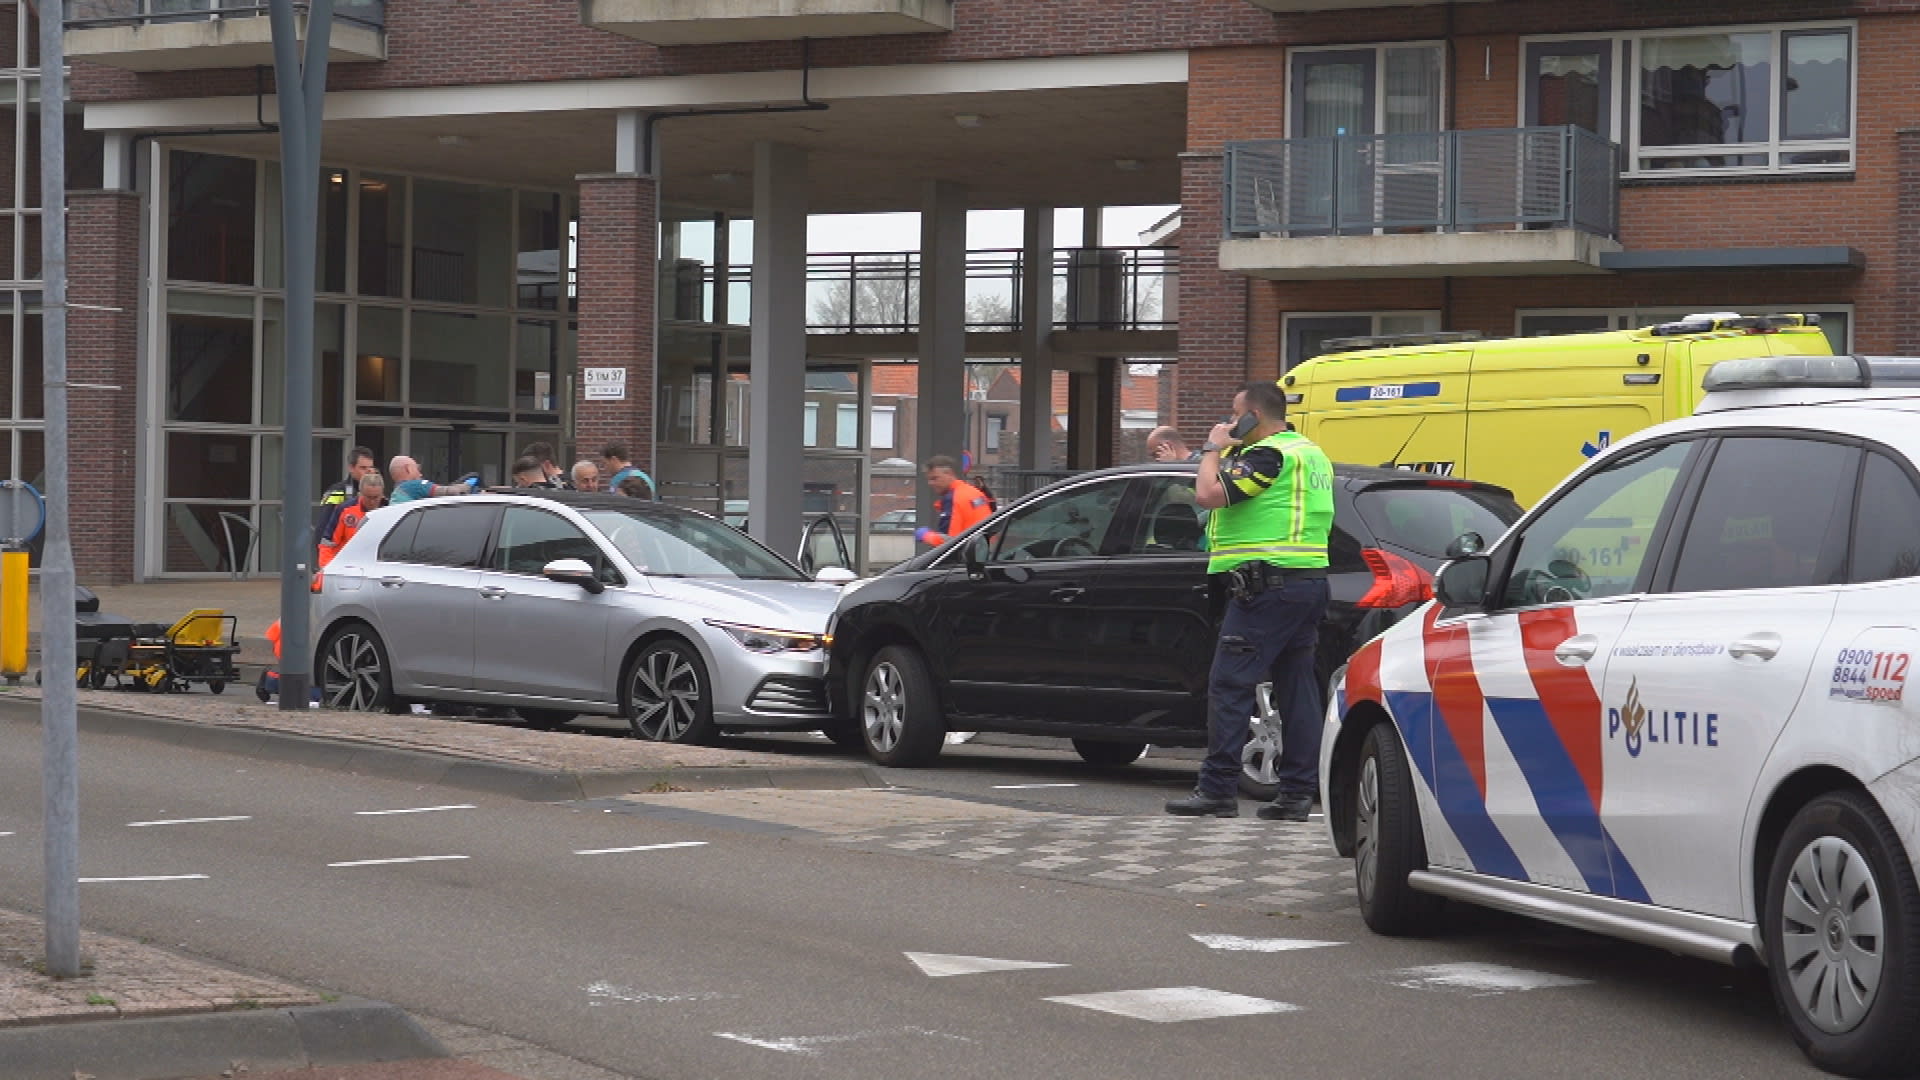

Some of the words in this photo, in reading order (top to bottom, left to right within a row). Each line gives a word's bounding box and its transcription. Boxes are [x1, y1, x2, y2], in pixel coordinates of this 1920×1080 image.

[611, 369, 623, 381] 37
[1373, 386, 1401, 397] 20-161
[1838, 648, 1873, 666] 0900
[1832, 666, 1866, 684] 8844
[1872, 652, 1910, 682] 112
[1866, 685, 1903, 702] spoed
[1608, 707, 1719, 758] POLITIE
